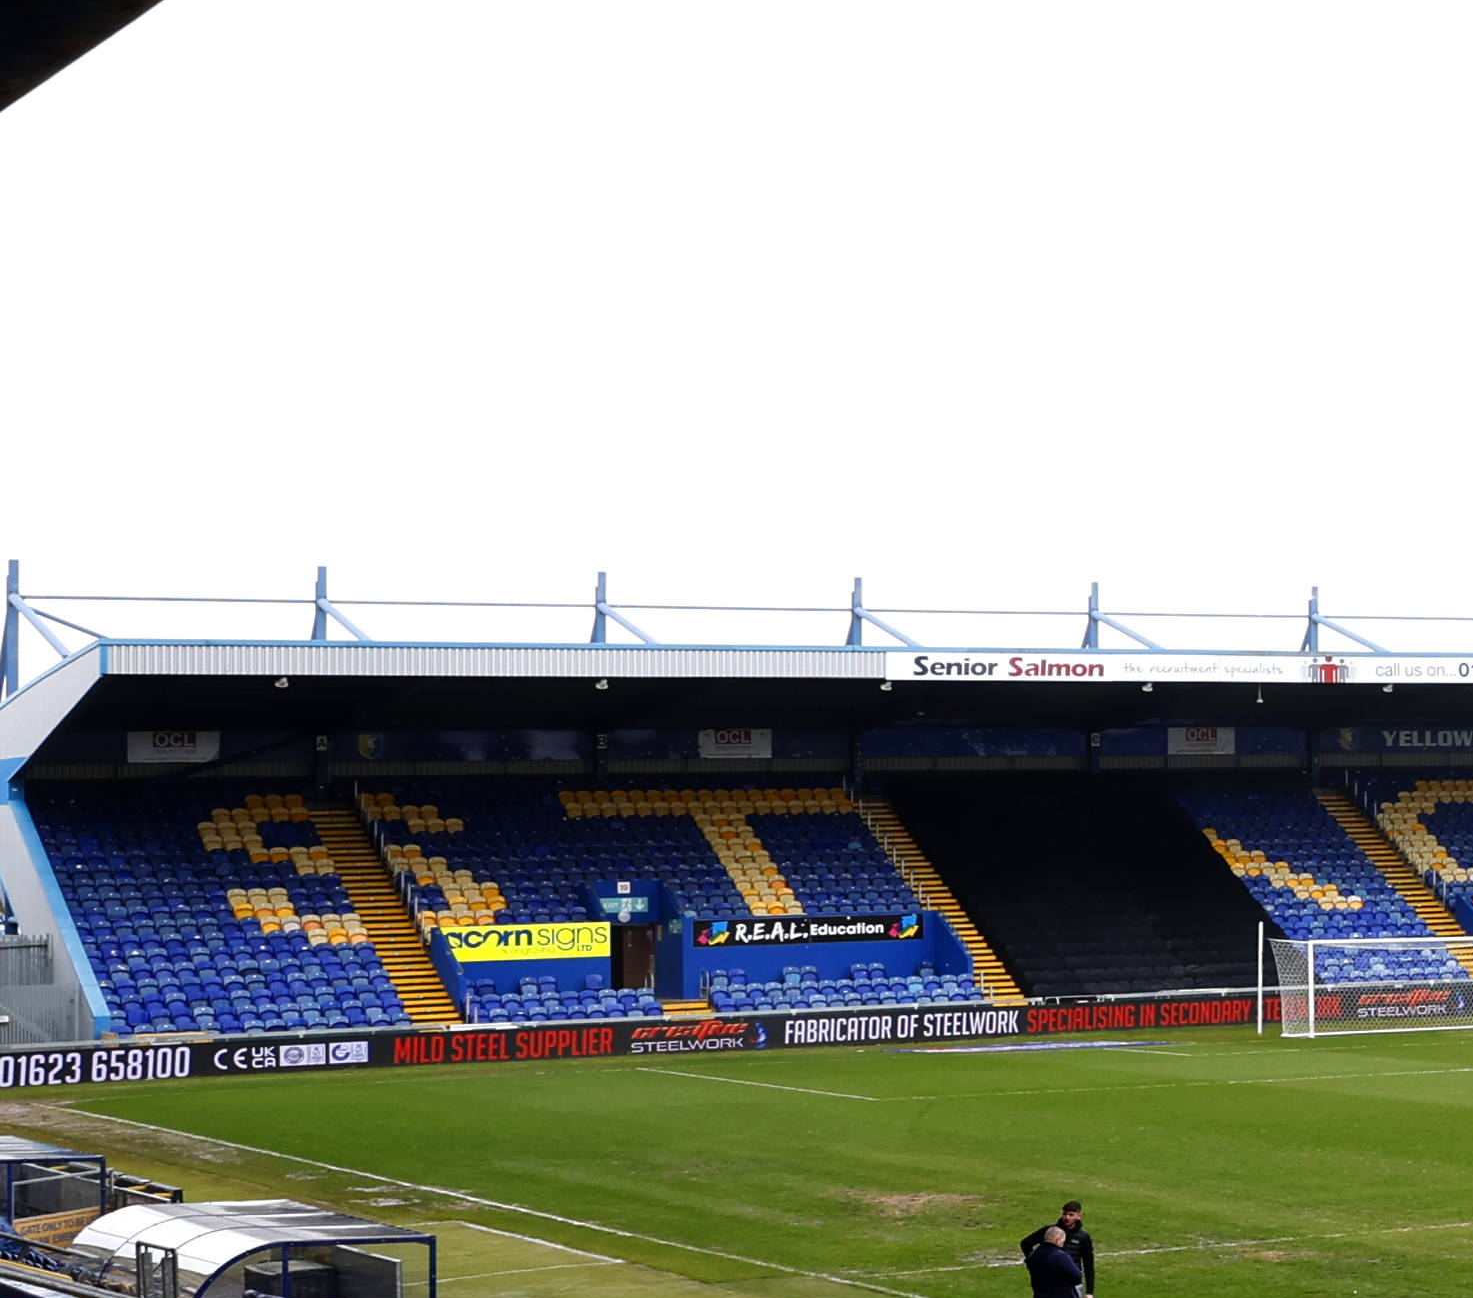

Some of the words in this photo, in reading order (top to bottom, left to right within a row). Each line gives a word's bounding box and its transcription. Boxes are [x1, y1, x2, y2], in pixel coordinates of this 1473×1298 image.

[913, 656, 998, 676] Senior
[1008, 657, 1104, 677] Salmon
[1123, 662, 1143, 673] the
[1150, 662, 1219, 674] recruitment
[1224, 662, 1284, 678] specialists
[154, 731, 197, 749] OCL
[537, 926, 608, 952] signs
[810, 923, 884, 936] Education
[784, 1017, 892, 1044] FABRICATOR
[897, 1014, 919, 1038] OF
[923, 1010, 1019, 1037] STEELWORK
[1027, 1006, 1135, 1033] SPECIALISING
[1139, 1005, 1156, 1027] IN
[1160, 1000, 1251, 1026] SECONDARY
[394, 1037, 445, 1064] MILD
[452, 1033, 509, 1062] STEEL
[516, 1027, 614, 1058] SUPPLIER
[631, 1038, 743, 1053] STEELWORK
[0, 1053, 81, 1087] 01623
[91, 1047, 190, 1081] 658100
